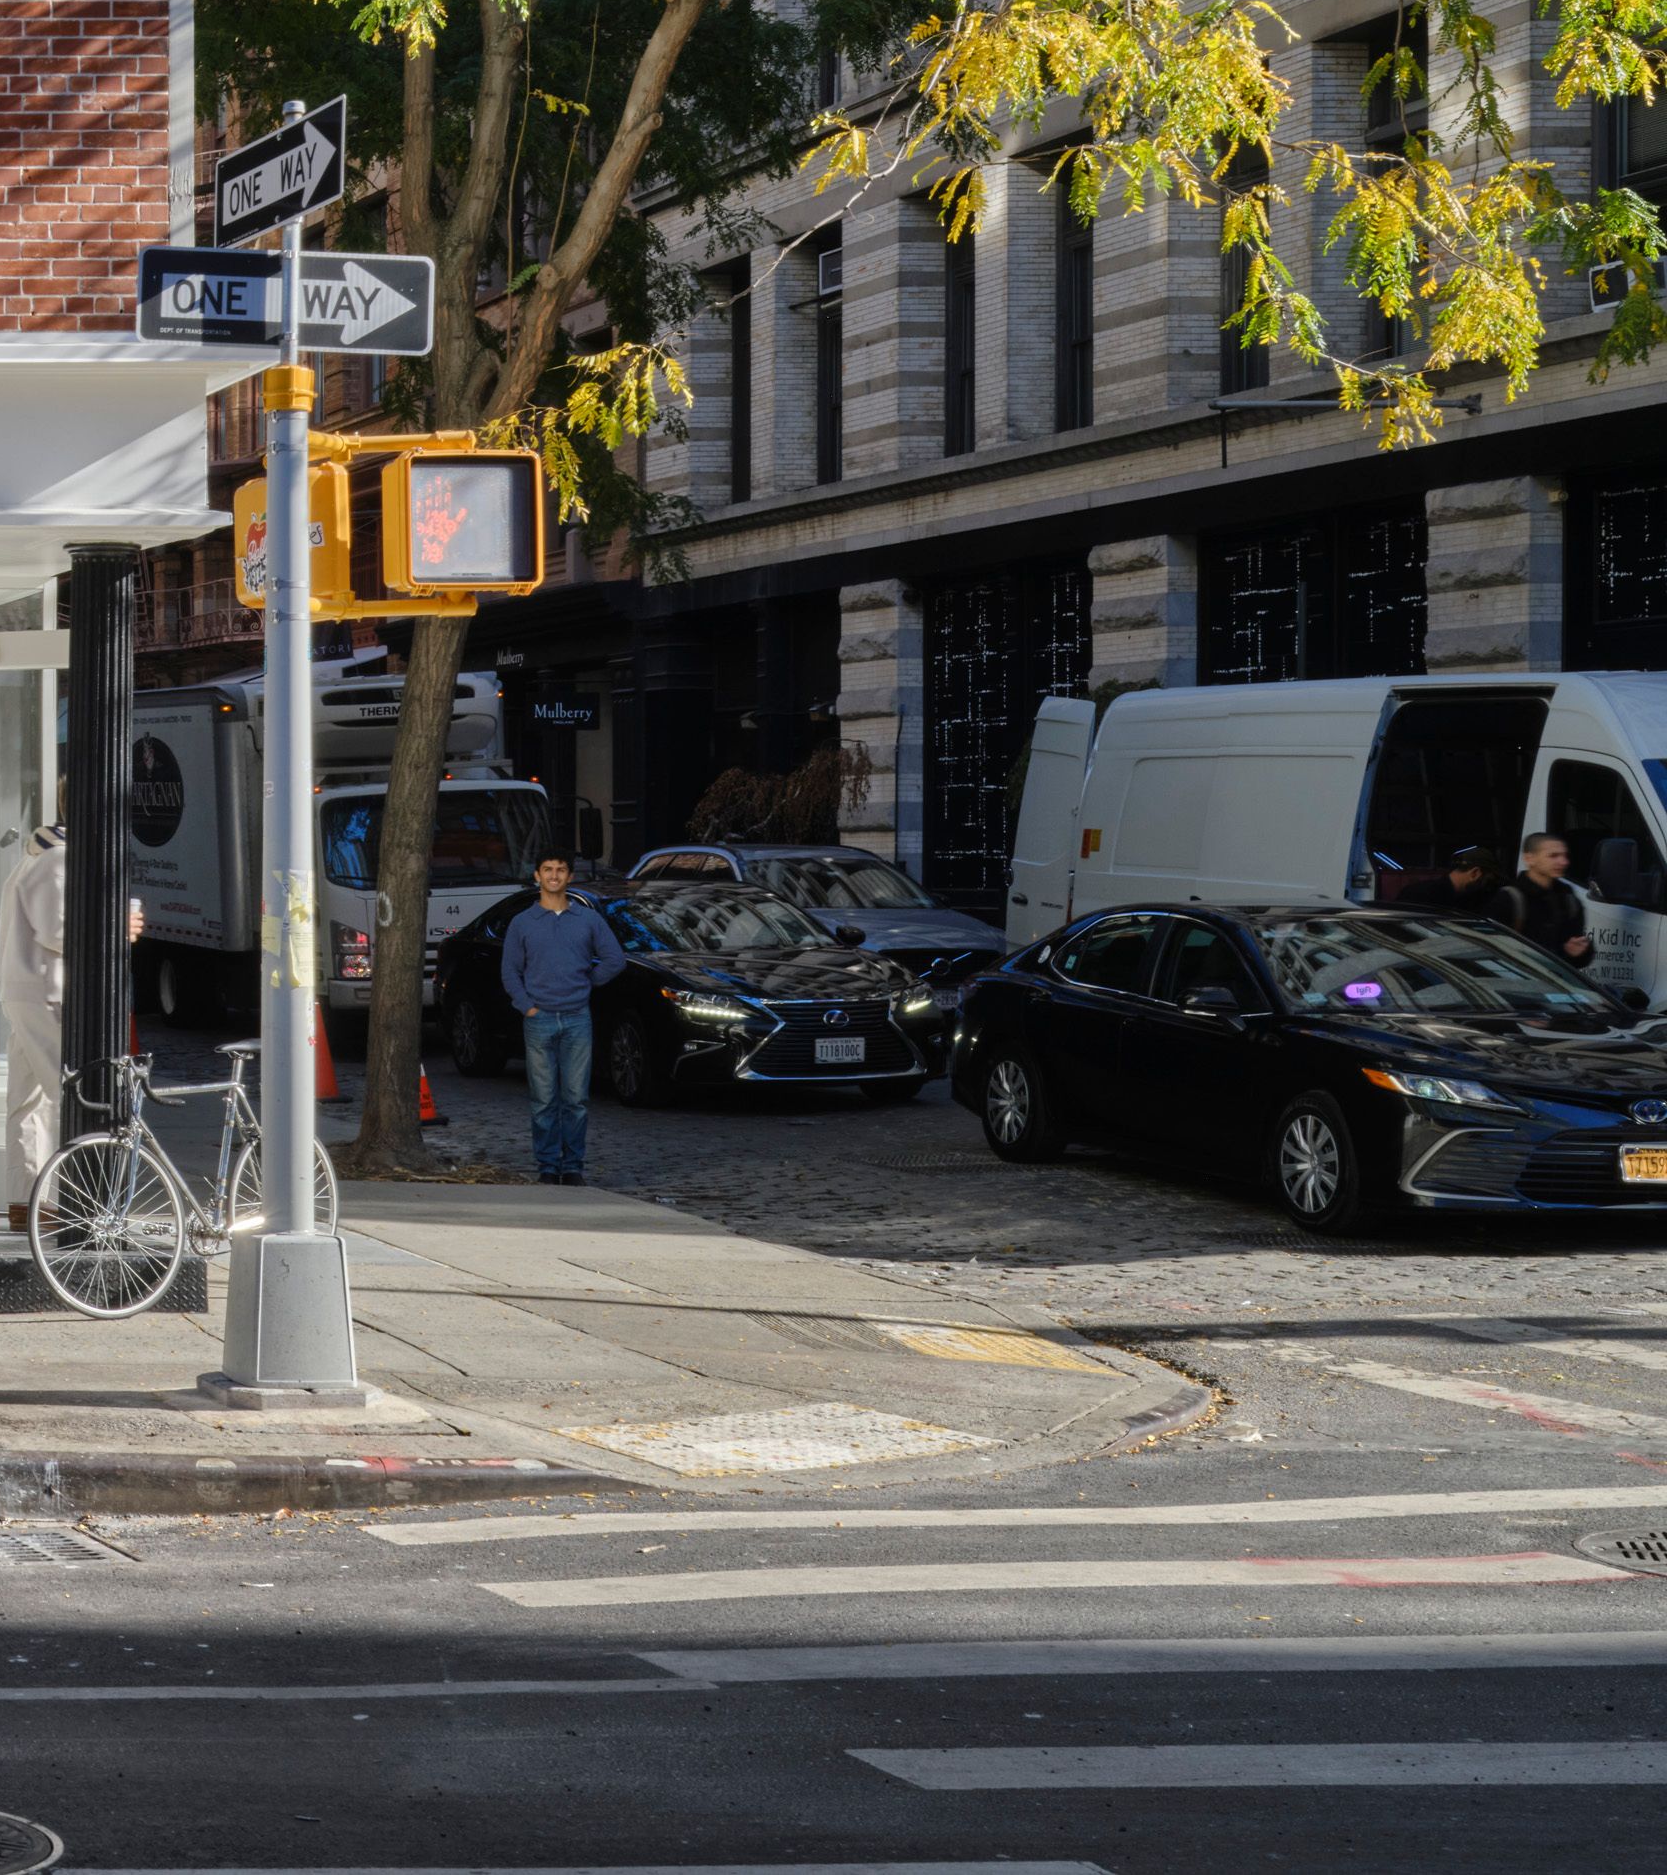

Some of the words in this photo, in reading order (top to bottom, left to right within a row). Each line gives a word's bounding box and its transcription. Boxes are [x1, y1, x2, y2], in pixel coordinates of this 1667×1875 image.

[229, 169, 263, 217] ONE
[280, 142, 317, 193] WAY
[172, 278, 248, 316] ONE
[302, 283, 382, 321] WAY
[497, 646, 525, 667] Mulberry
[359, 707, 402, 717] THERM
[534, 702, 593, 722] Mulberry
[446, 905, 460, 915] 44
[1599, 928, 1619, 946] Kid
[1622, 930, 1642, 947] Inc
[1626, 950, 1635, 963] St
[1601, 966, 1611, 978] NY
[1612, 967, 1634, 981] 11231
[1627, 1156, 1667, 1174] T7159
